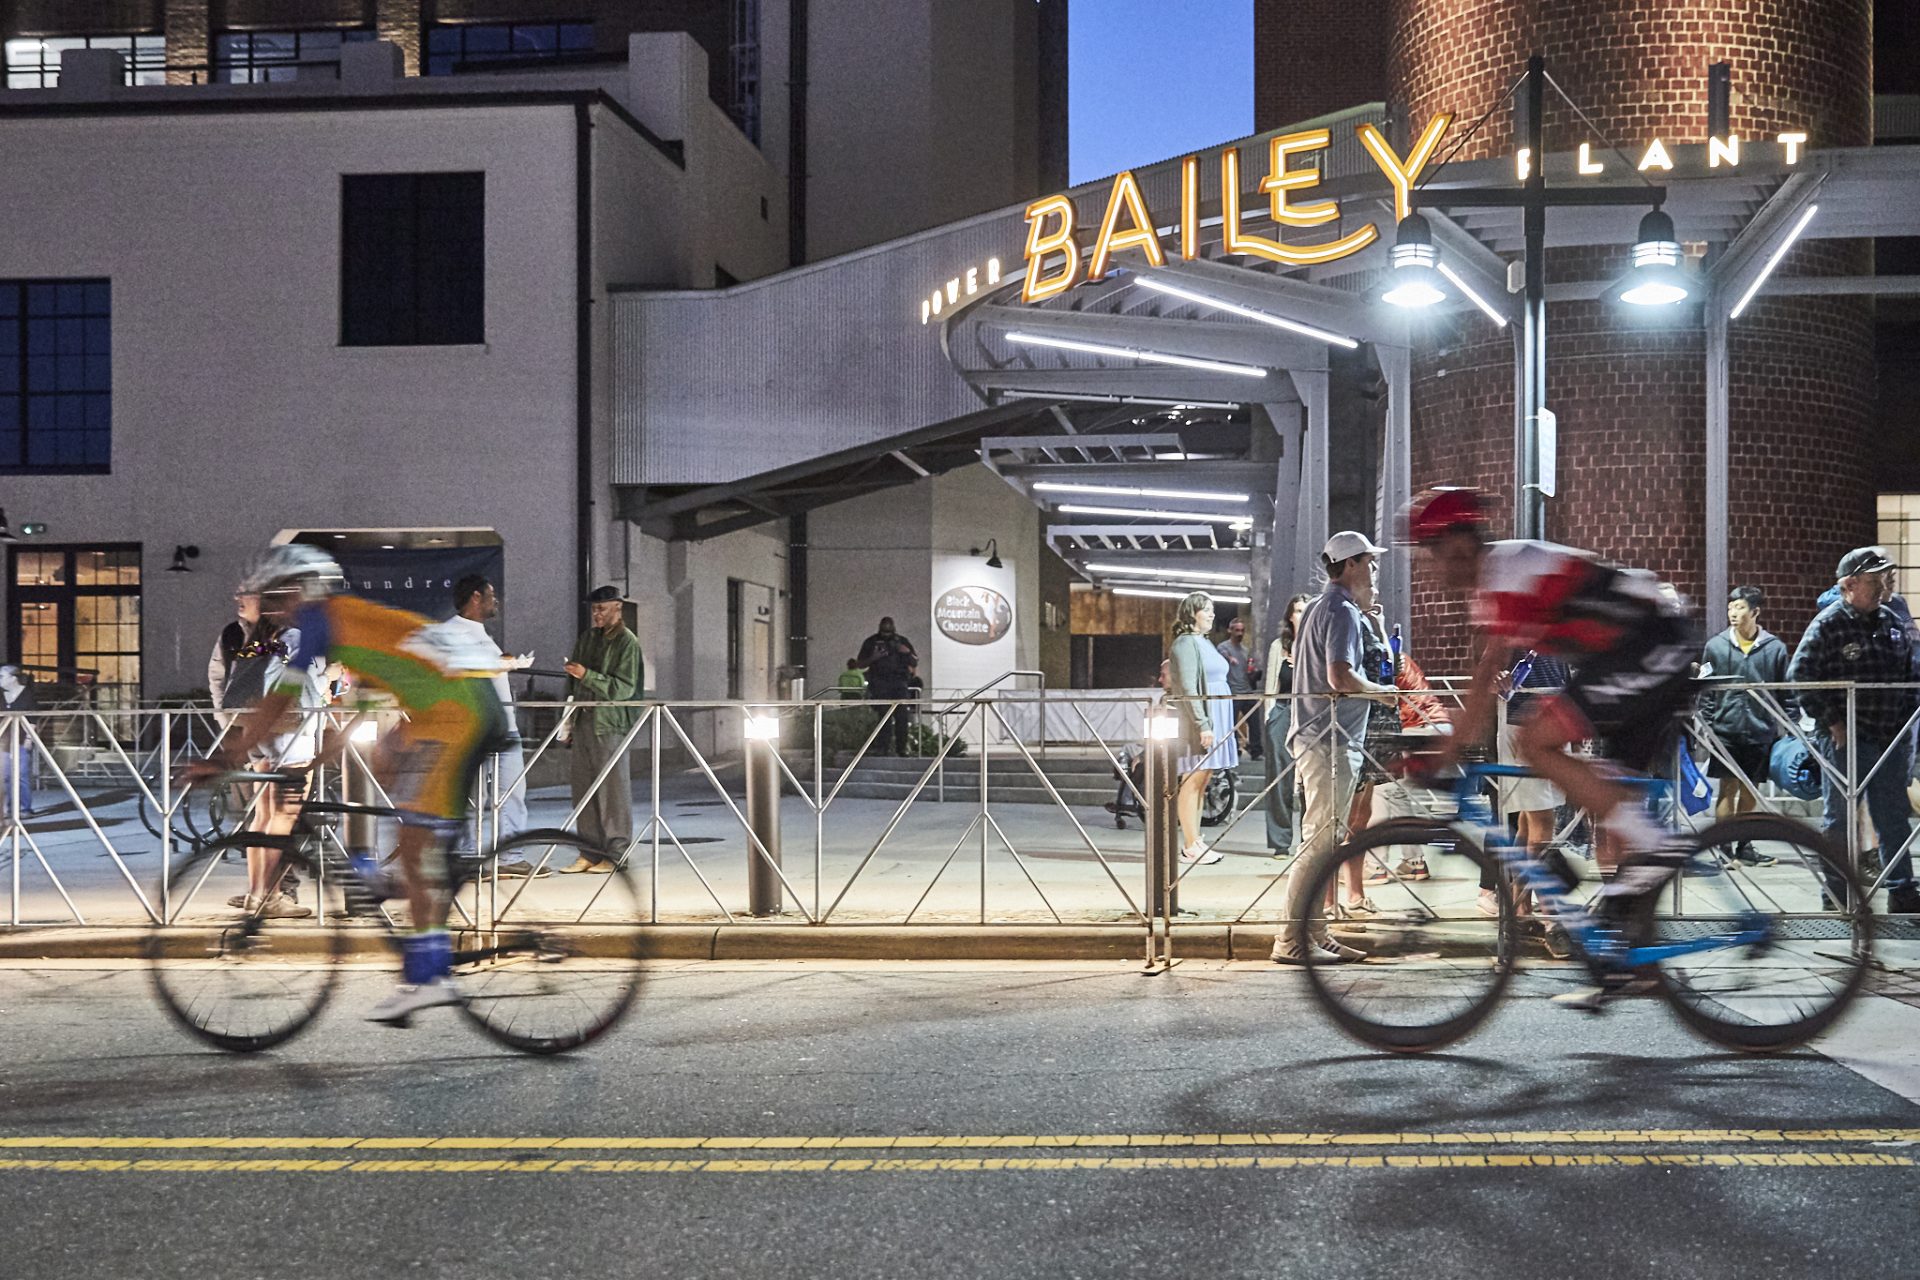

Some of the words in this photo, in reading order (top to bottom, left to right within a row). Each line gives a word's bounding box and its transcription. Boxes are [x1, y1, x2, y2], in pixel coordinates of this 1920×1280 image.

[922, 257, 1000, 325] POWER
[1022, 112, 1455, 303] BAILEY
[343, 576, 452, 590] hundre
[937, 607, 981, 619] Mountain
[942, 620, 989, 632] Chocolate
